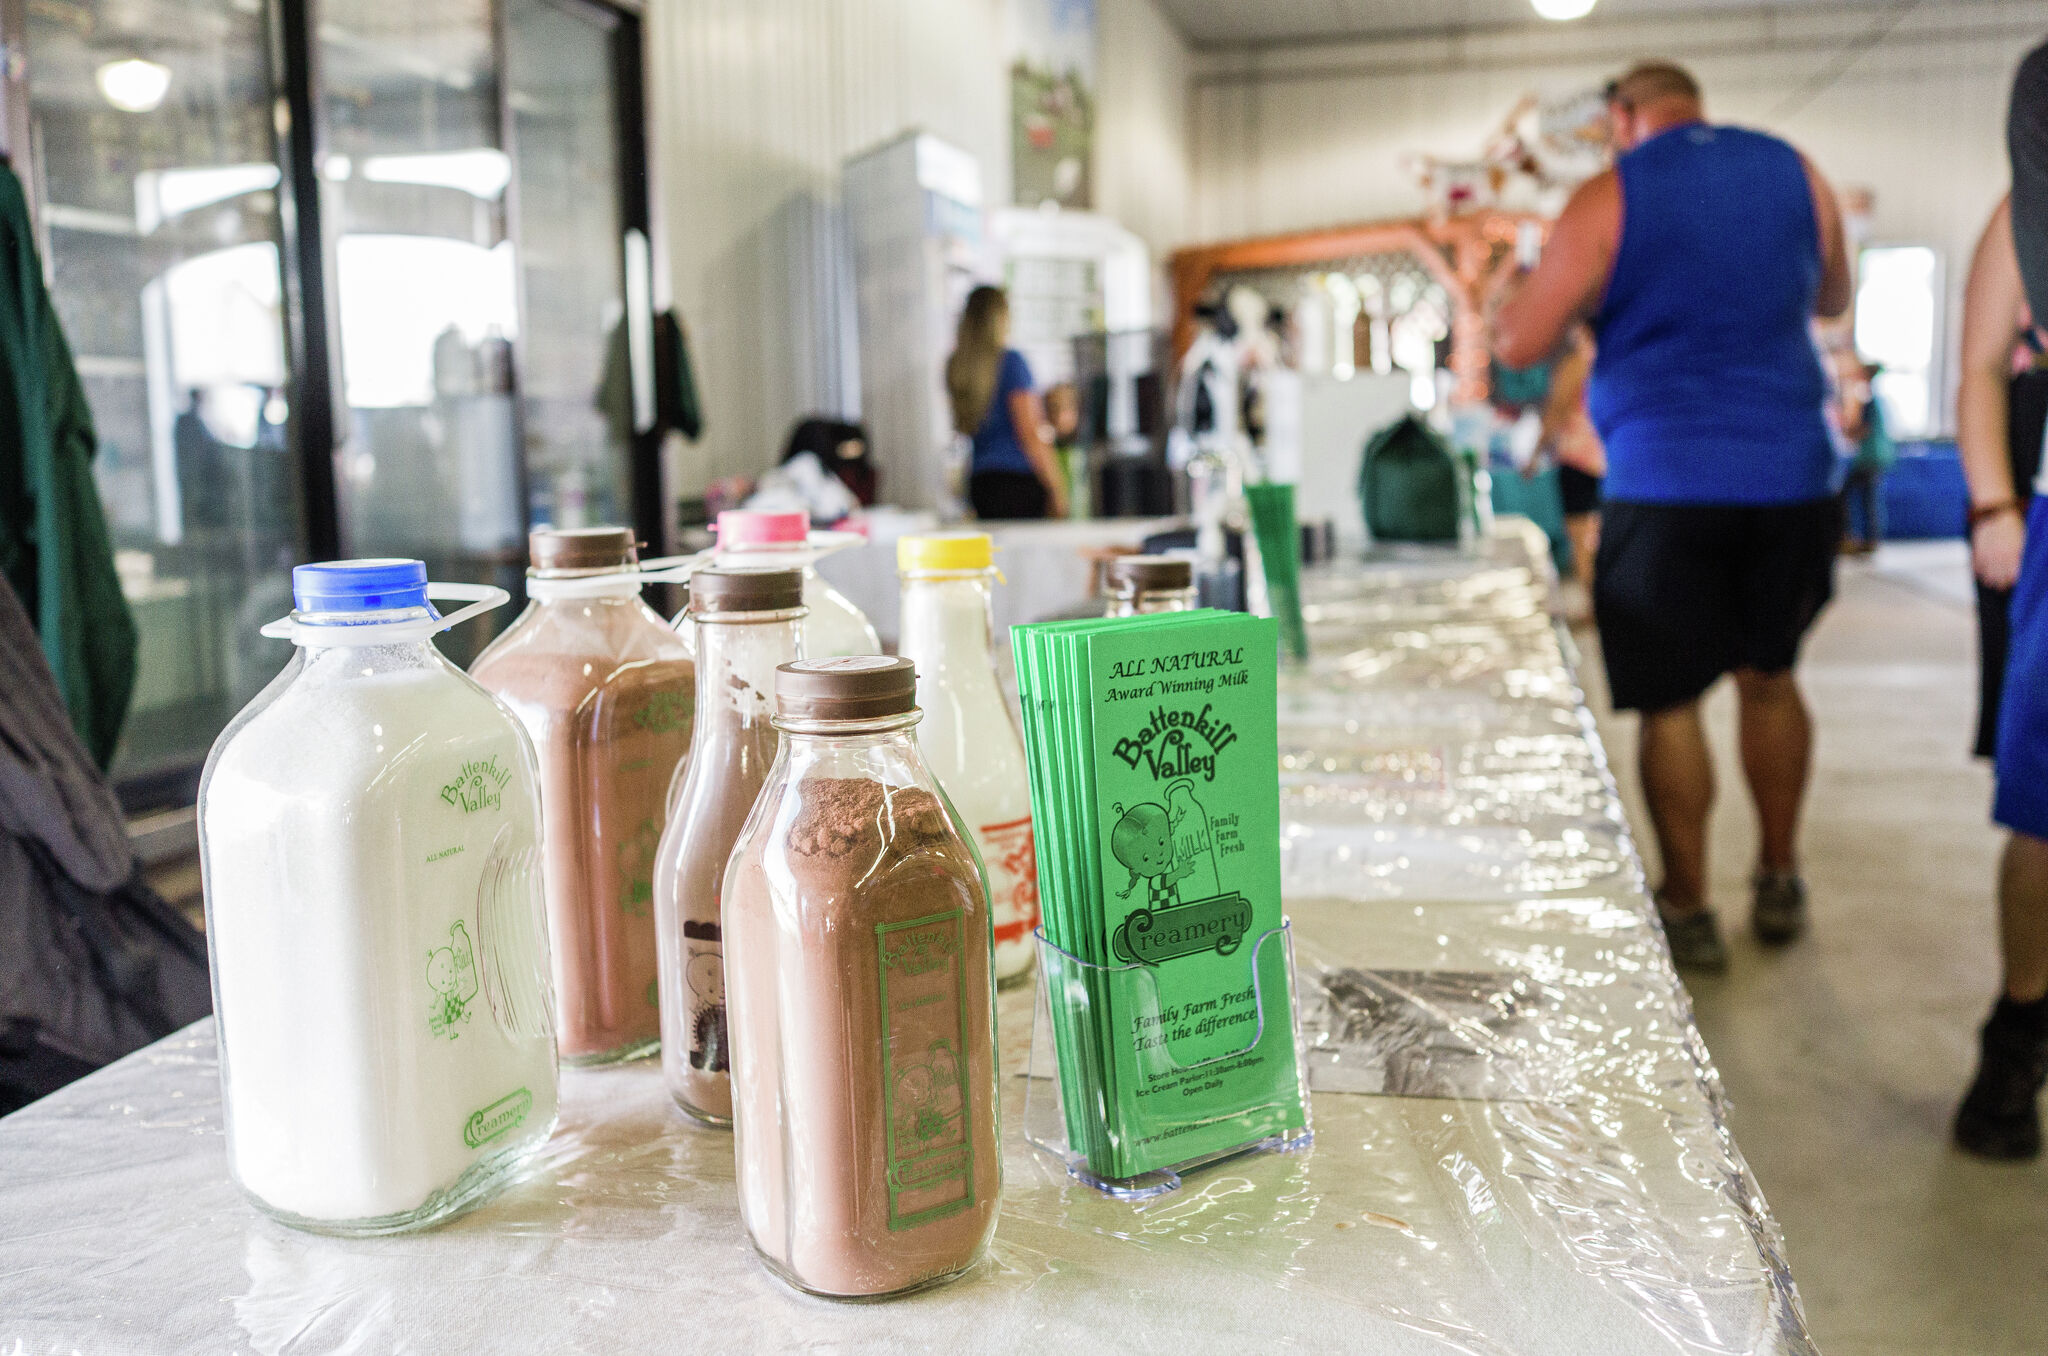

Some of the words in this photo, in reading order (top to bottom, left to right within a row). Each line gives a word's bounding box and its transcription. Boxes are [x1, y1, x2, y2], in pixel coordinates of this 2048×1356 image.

[1109, 659, 1145, 679] ALL
[1150, 647, 1244, 675] NATURAL
[1104, 681, 1157, 702] Award
[1157, 677, 1215, 694] Winning
[1218, 669, 1248, 688] Milk
[1112, 703, 1237, 770] Battenkill
[1144, 729, 1216, 782] Valley
[441, 754, 512, 806] Battenkill
[460, 775, 501, 814] Valley
[1210, 813, 1240, 831] Family
[1216, 830, 1238, 844] Farm
[1220, 839, 1245, 858] Fresh
[1124, 908, 1245, 967] Creamery
[1131, 1005, 1179, 1034] Family
[1182, 999, 1217, 1020] Farm
[1133, 1033, 1168, 1051] Taste
[1172, 1024, 1192, 1041] the
[1136, 1089, 1150, 1097] Ice
[1152, 1081, 1178, 1093] Cream
[1183, 1085, 1203, 1096] Open
[1205, 1080, 1223, 1091] Daily
